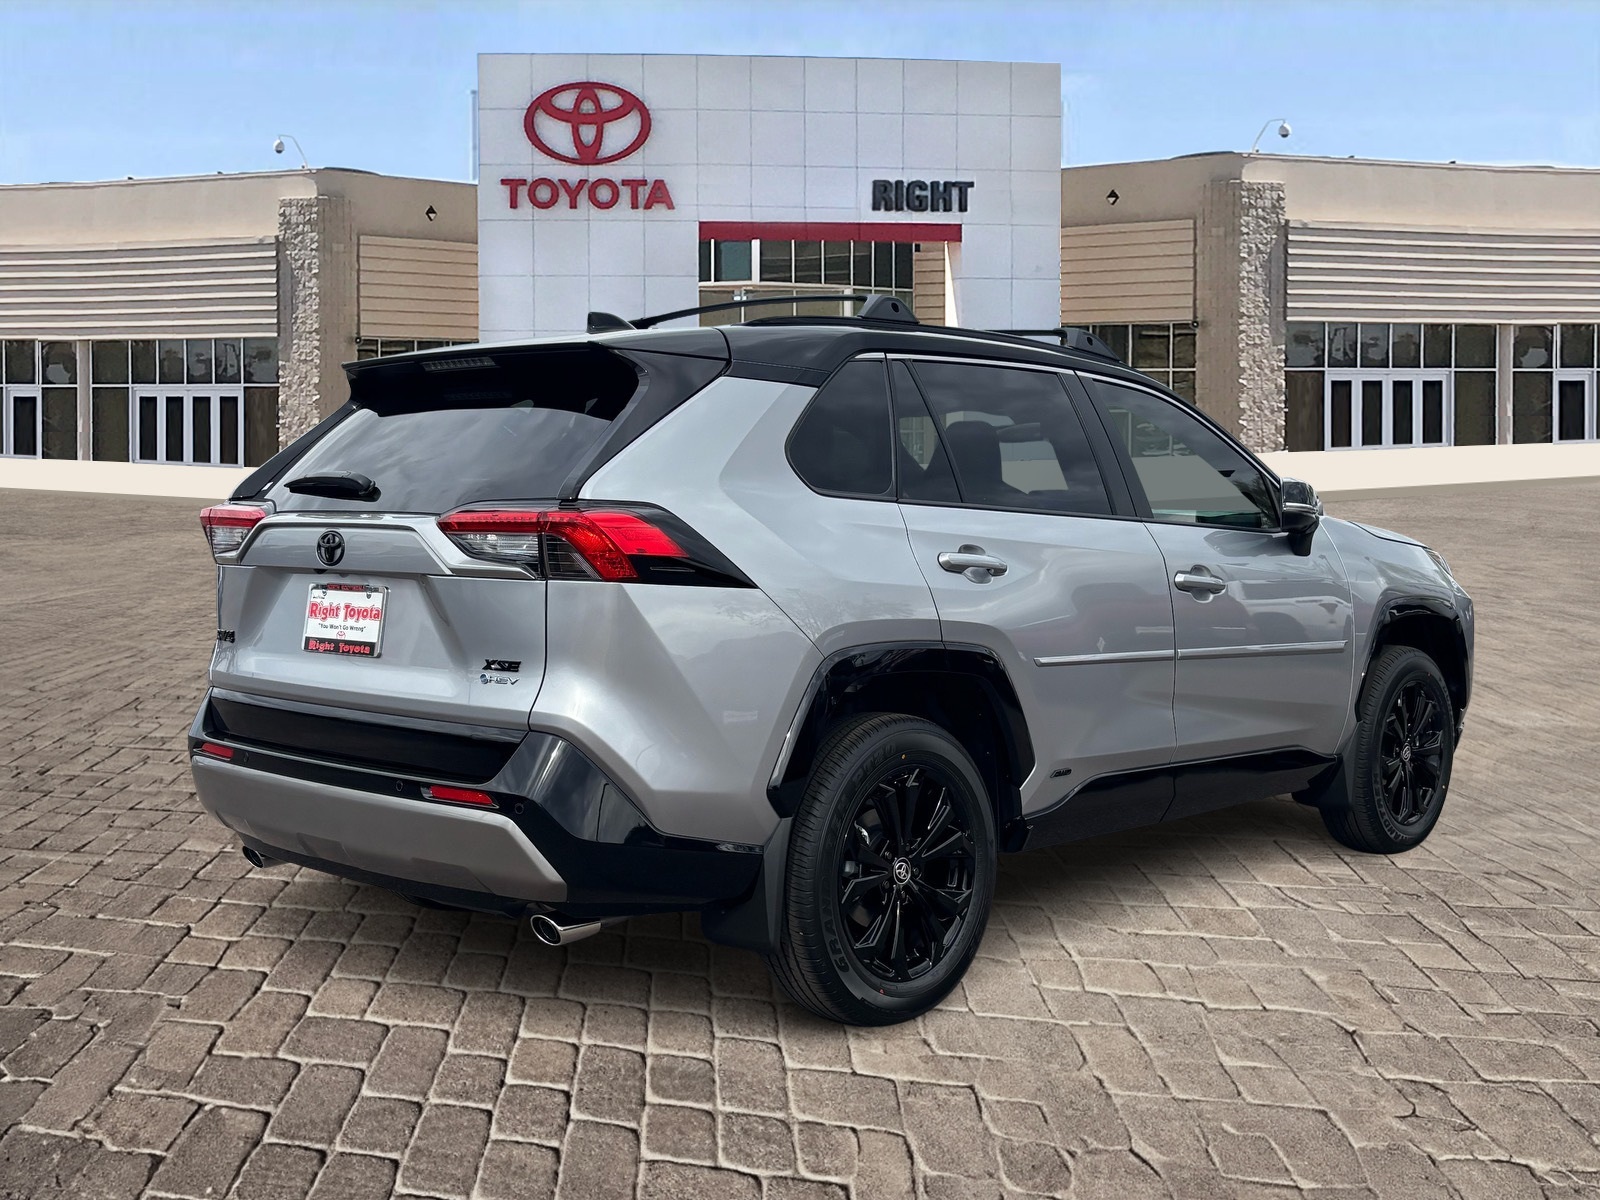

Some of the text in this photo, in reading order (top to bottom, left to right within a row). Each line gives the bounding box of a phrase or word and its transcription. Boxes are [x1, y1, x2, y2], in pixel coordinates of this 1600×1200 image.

[501, 178, 675, 210] TOYOTA
[872, 180, 975, 213] RIGHT
[308, 601, 382, 623] Right Toyota
[308, 639, 371, 654] Right Toyota
[482, 659, 521, 672] XSE
